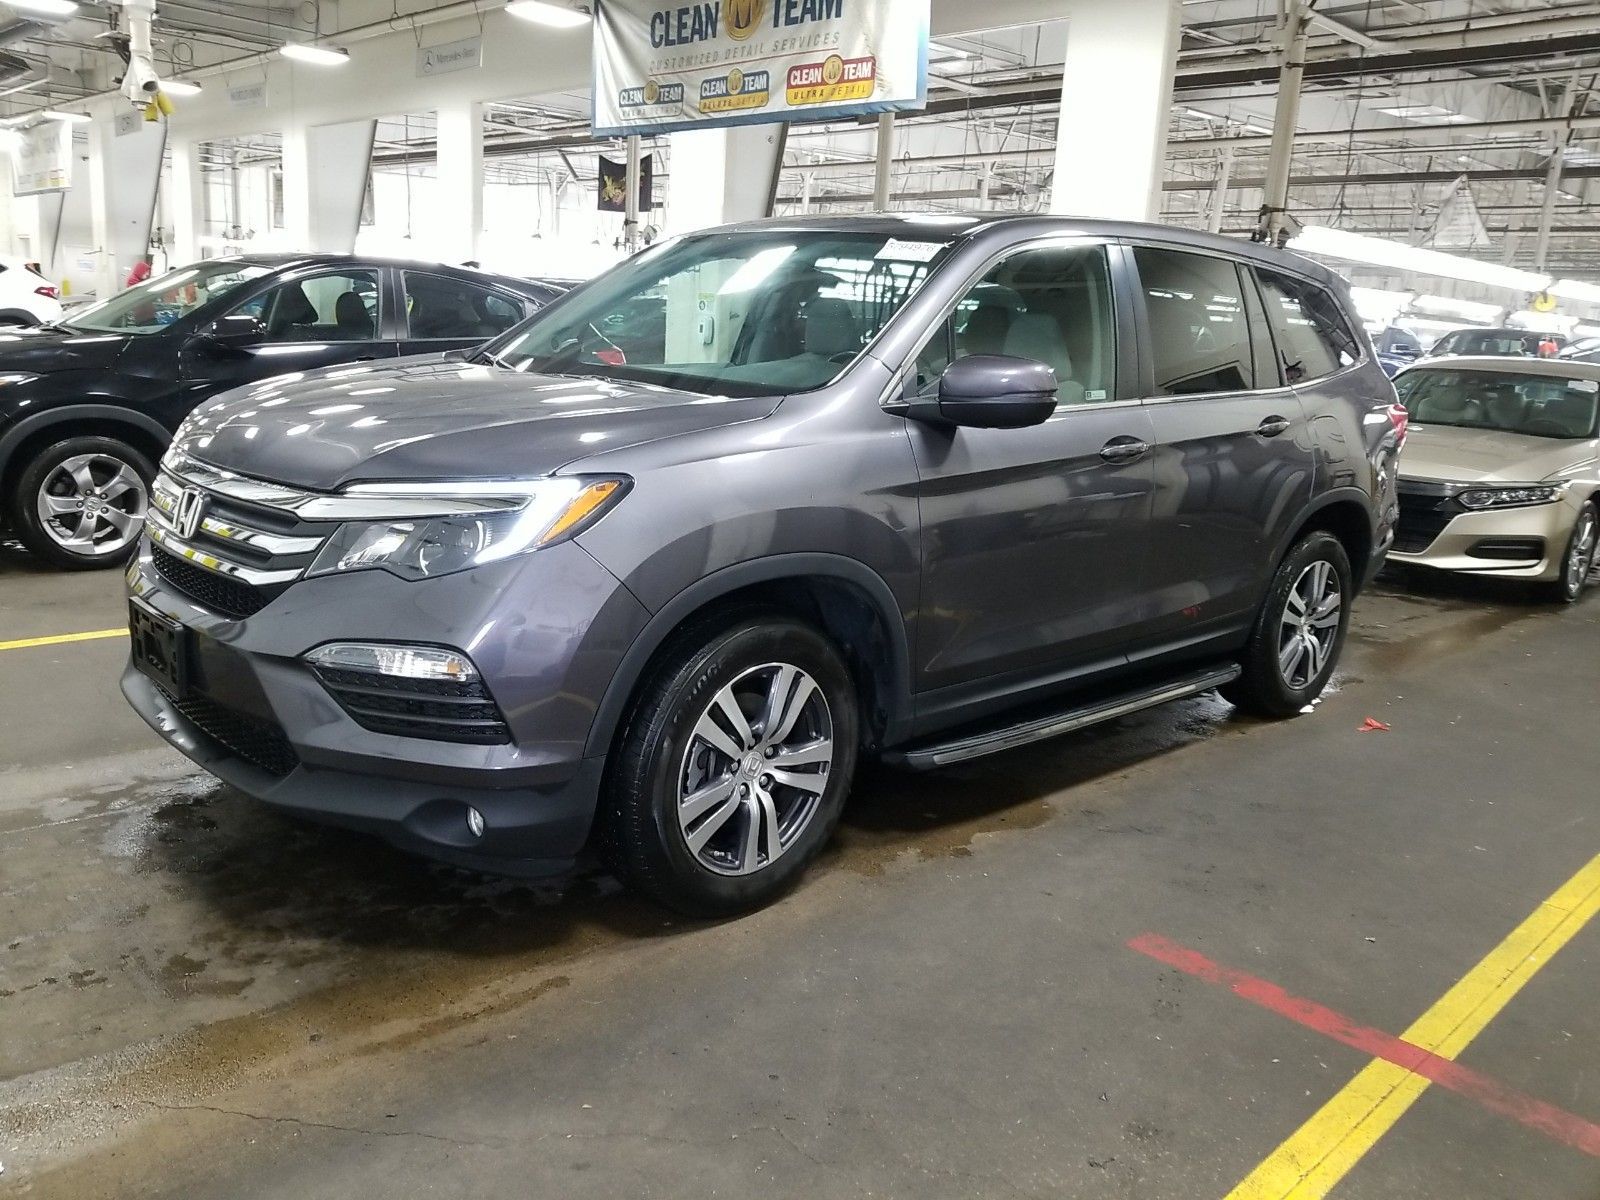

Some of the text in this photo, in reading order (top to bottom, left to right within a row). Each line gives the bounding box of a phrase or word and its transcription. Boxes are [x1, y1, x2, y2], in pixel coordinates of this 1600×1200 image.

[651, 0, 842, 48] CLEAN TEAM
[650, 31, 840, 73] CUSTOMIZED DETAIL SERVICES
[702, 74, 767, 97] CLEAN TEAM
[790, 61, 872, 86] CLEAN TEAM
[620, 86, 682, 105] CLEAN TEAM
[793, 84, 866, 100] ULTRA DETAIL
